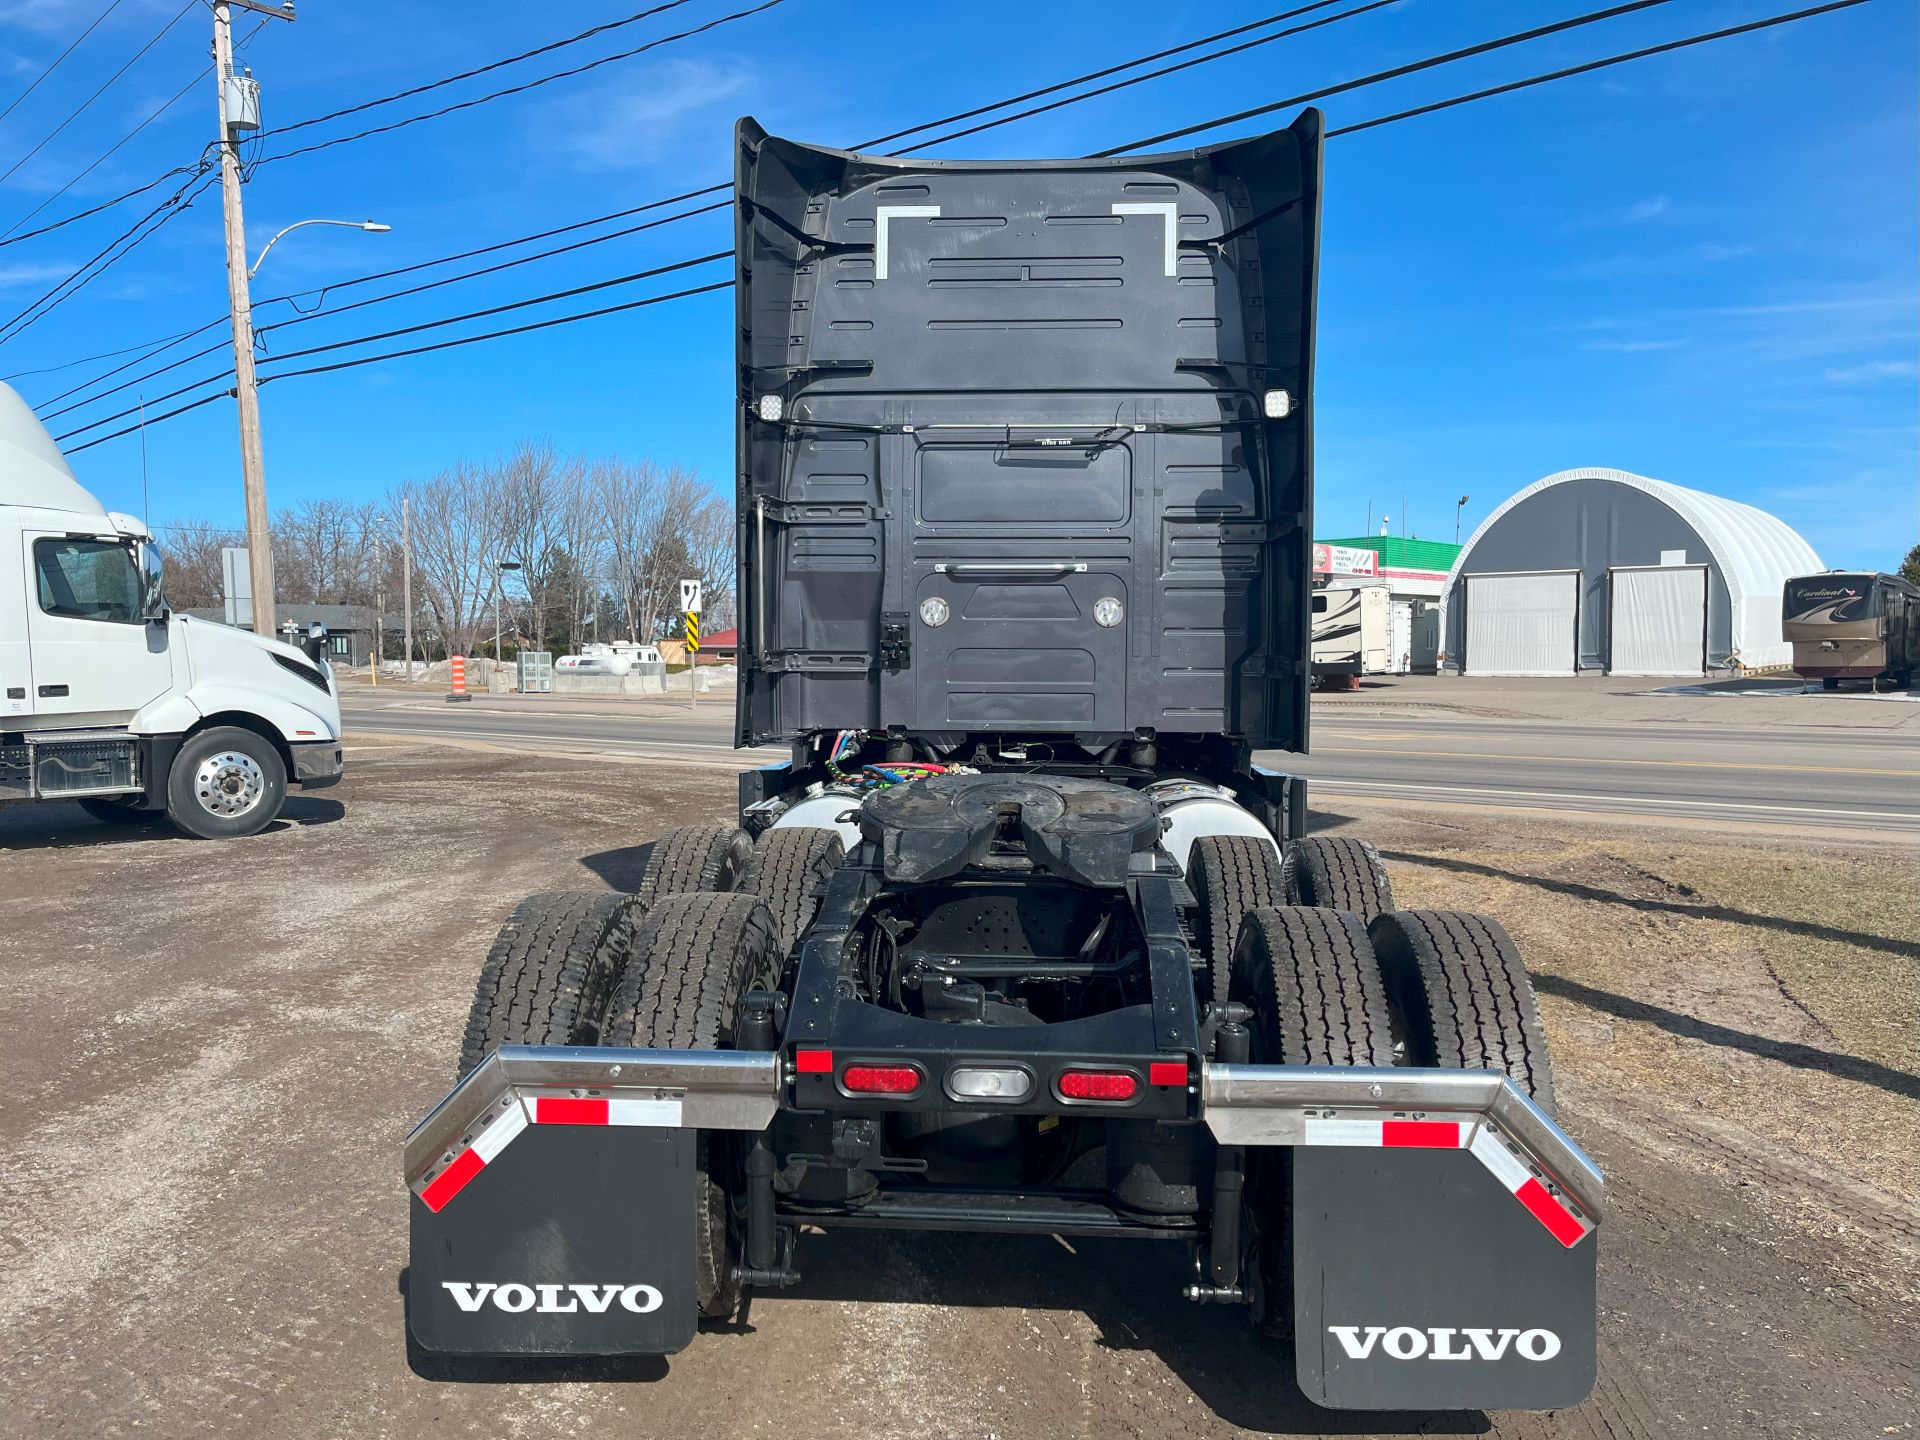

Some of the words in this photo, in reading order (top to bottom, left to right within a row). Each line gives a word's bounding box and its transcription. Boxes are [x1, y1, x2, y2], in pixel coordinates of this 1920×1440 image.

[1797, 587, 1847, 598] Cardinal
[441, 1281, 663, 1313] VOLVO
[1328, 1325, 1561, 1361] VOLVO
